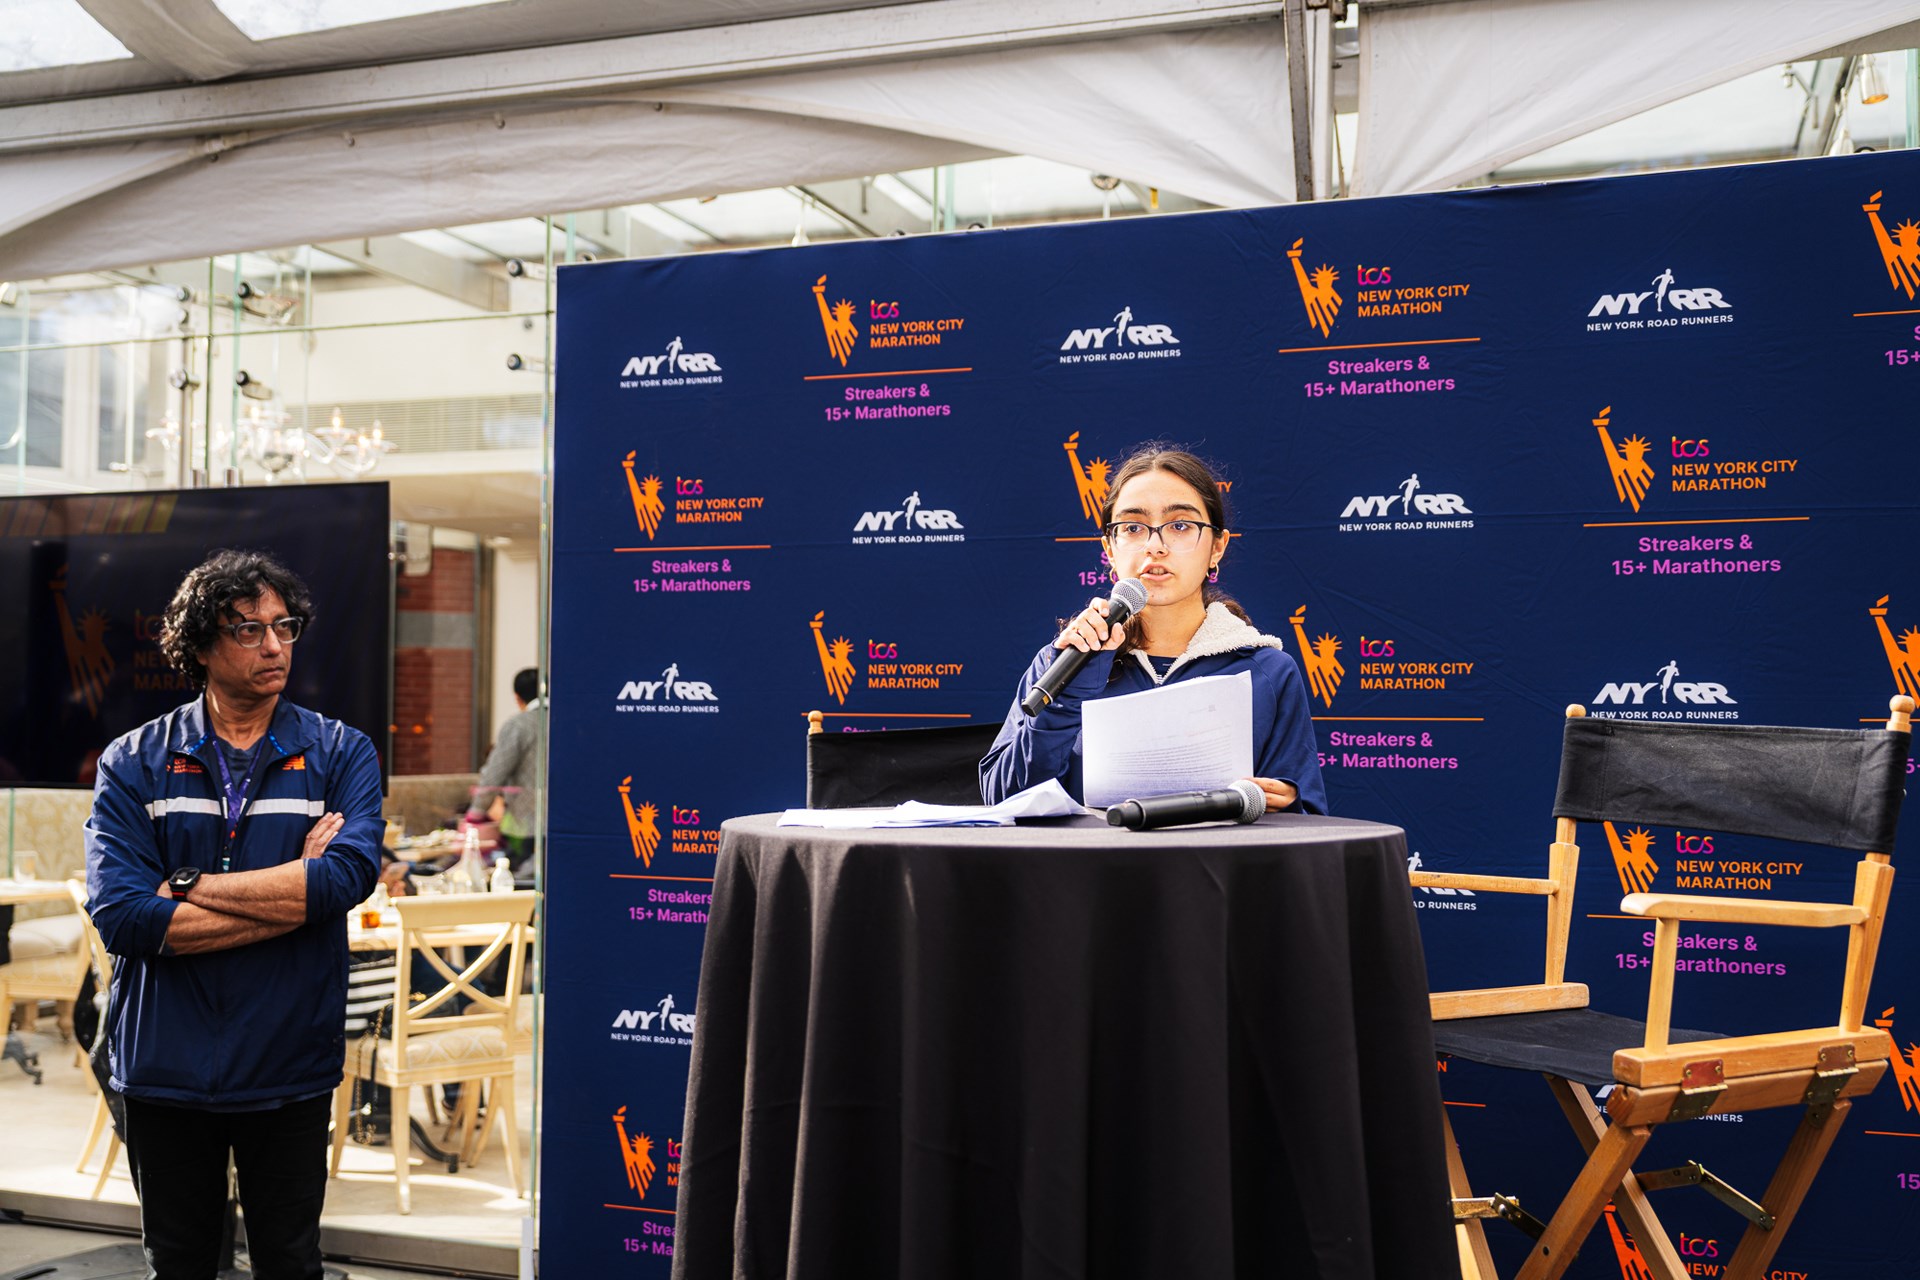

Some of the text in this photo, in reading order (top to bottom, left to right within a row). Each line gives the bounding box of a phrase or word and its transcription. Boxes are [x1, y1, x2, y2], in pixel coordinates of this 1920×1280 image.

[1357, 264, 1392, 286] tcs
[1357, 284, 1470, 303] NEW YORK CITY
[870, 299, 900, 320] tcs
[1358, 301, 1442, 318] MARATHON
[870, 318, 964, 335] NEW YORK CITY
[1587, 315, 1733, 331] NEW YORK ROAD RUNNERS
[870, 333, 941, 349] MARATHON
[1060, 349, 1181, 363] NEW YORK ROAD RUNNERS
[1328, 355, 1430, 375] Streakers &
[640, 379, 660, 387] YORK
[662, 378, 684, 386] ROAD
[686, 376, 723, 384] RUNNERS
[1304, 378, 1455, 397] 15+ Marathoners
[845, 383, 930, 401] Streakers &
[825, 404, 951, 421] 15+ Marathoners
[1671, 436, 1710, 458] tcs
[1672, 459, 1798, 476] NEW YORK CITY
[676, 476, 704, 495] tcs
[1672, 477, 1766, 492] MARATHON
[676, 497, 764, 511] NEW YORK CITY
[676, 510, 742, 523] MARATHON
[1365, 523, 1392, 531] YORK
[1395, 522, 1423, 530] ROAD
[1426, 520, 1474, 529] RUNNERS
[874, 536, 897, 544] YORK
[898, 535, 923, 543] ROAD
[924, 534, 965, 542] RUNNERS
[1639, 534, 1753, 552] Streakers &
[652, 559, 731, 574] Streakers &
[1612, 558, 1781, 575] 15+ Marathoners
[633, 578, 751, 592] 15+ Marathoners
[1078, 571, 1108, 586] 15+
[868, 639, 898, 659] tcs
[1360, 636, 1395, 657] tcs
[868, 664, 963, 675] NEW YORK CITY
[1360, 662, 1474, 675] NEW YORK CITY
[868, 677, 939, 689] MARATHON
[1360, 678, 1445, 690] MARATHON
[658, 705, 681, 713] ROAD
[682, 705, 719, 713] RUNNERS
[1591, 711, 1739, 719] NEW YORK ROAD RUNNERS
[1330, 731, 1433, 747] Streakers &
[1342, 753, 1459, 769] Marathoners
[672, 805, 700, 825] tcs
[672, 829, 700, 841] NEW
[1676, 831, 1714, 854] tcs
[1676, 860, 1803, 875] NEW YORK CITY
[1676, 876, 1771, 890] MARATHON
[629, 906, 654, 921] 15+
[1428, 901, 1477, 911] RUNNERS
[1642, 931, 1758, 951] Seakers &
[1615, 953, 1787, 976] 15+ arathoners
[610, 1032, 629, 1041] NEW
[631, 1034, 652, 1043] YORK
[653, 1035, 676, 1045] ROAD
[624, 1238, 649, 1253] 15+
[1680, 1232, 1719, 1258] tcs
